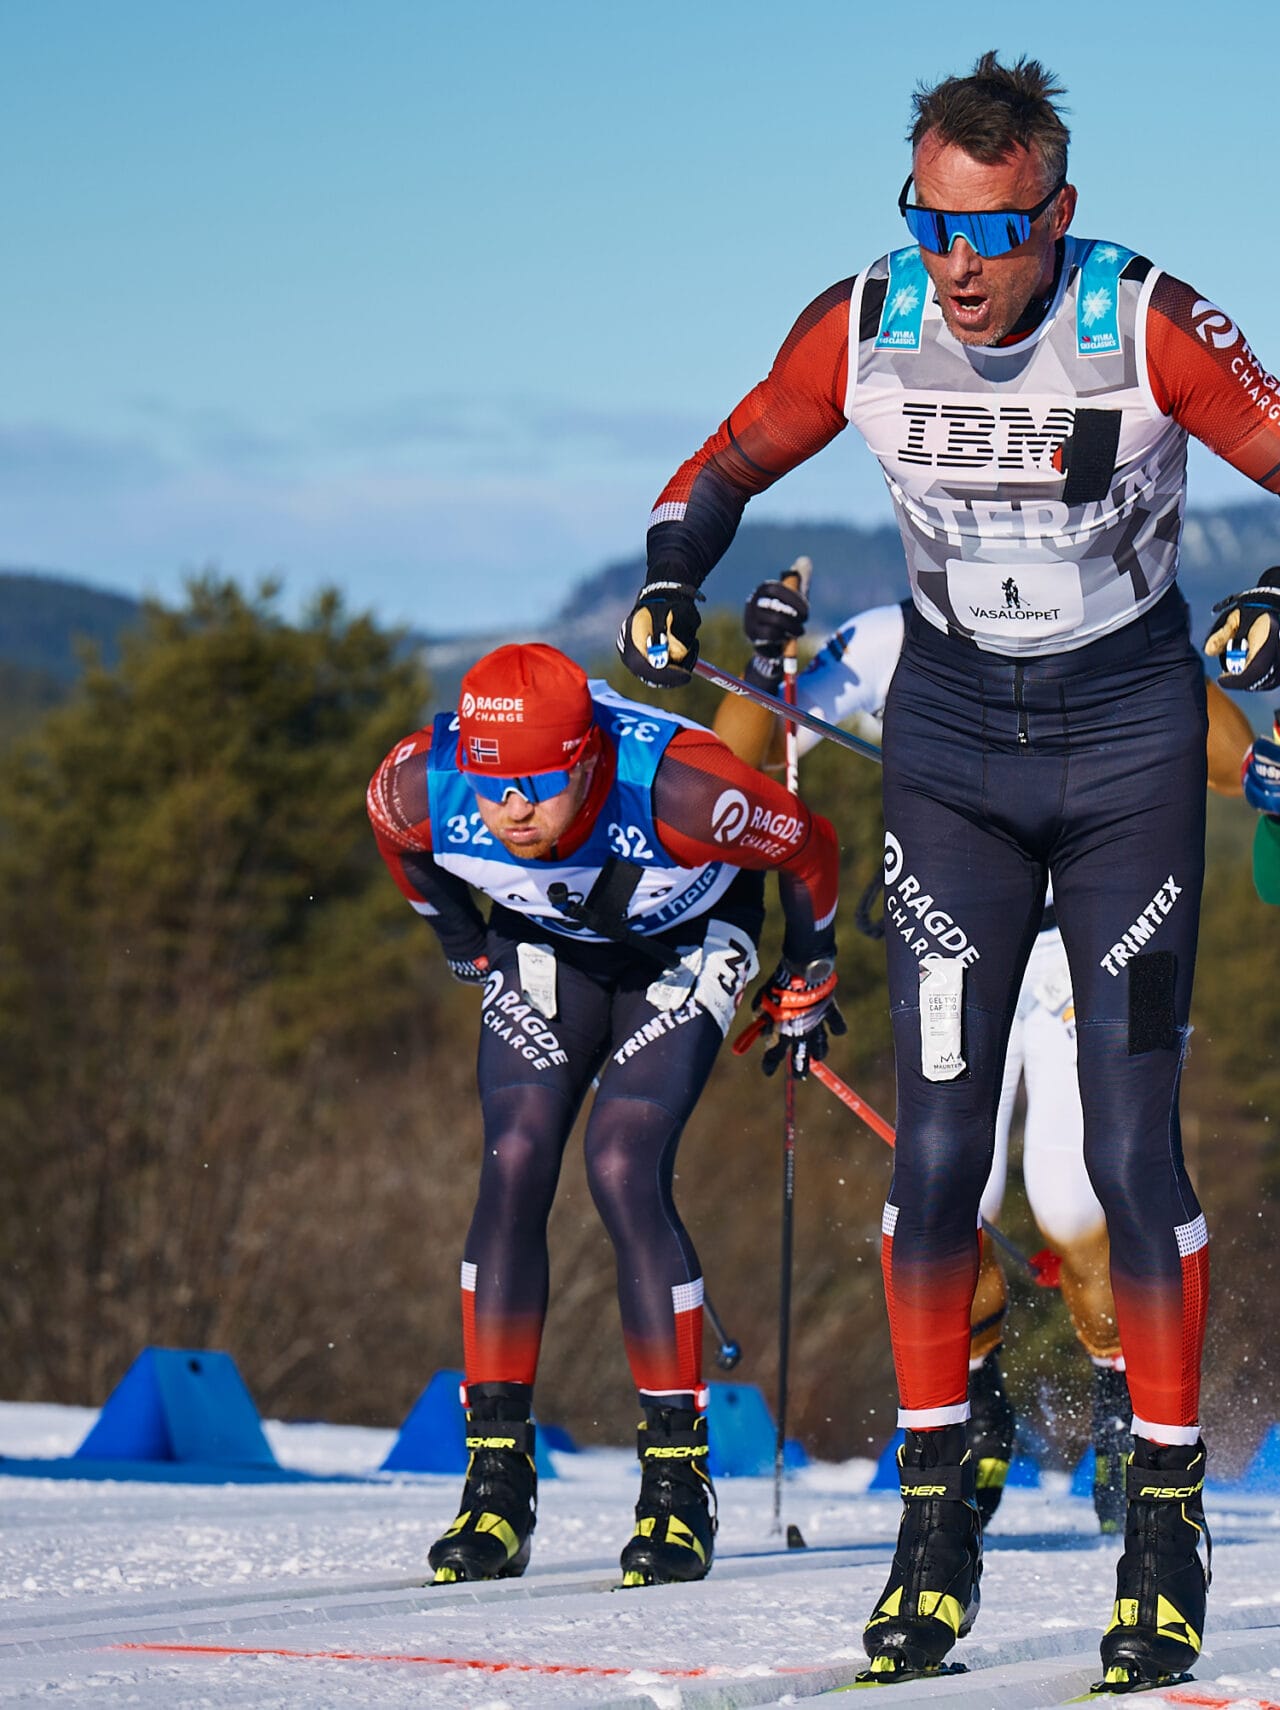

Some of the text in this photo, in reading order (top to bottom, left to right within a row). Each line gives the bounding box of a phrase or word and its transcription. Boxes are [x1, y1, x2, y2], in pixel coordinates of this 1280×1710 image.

[898, 403, 1076, 469] IBM
[969, 606, 1061, 621] VASALOPPET
[475, 712, 524, 722] CHARGE
[477, 697, 524, 711] RAGDE
[447, 812, 493, 846] 32
[608, 822, 654, 860] 32
[740, 834, 787, 858] CHARGE
[750, 806, 804, 844] RAGDE
[887, 895, 943, 960] CHAR
[897, 875, 981, 969] RAGDE
[1100, 875, 1183, 977] TRIMTEX
[484, 1010, 551, 1070] CHARGE
[495, 990, 569, 1066] RAGDE
[613, 1000, 702, 1065] TRIMTEX
